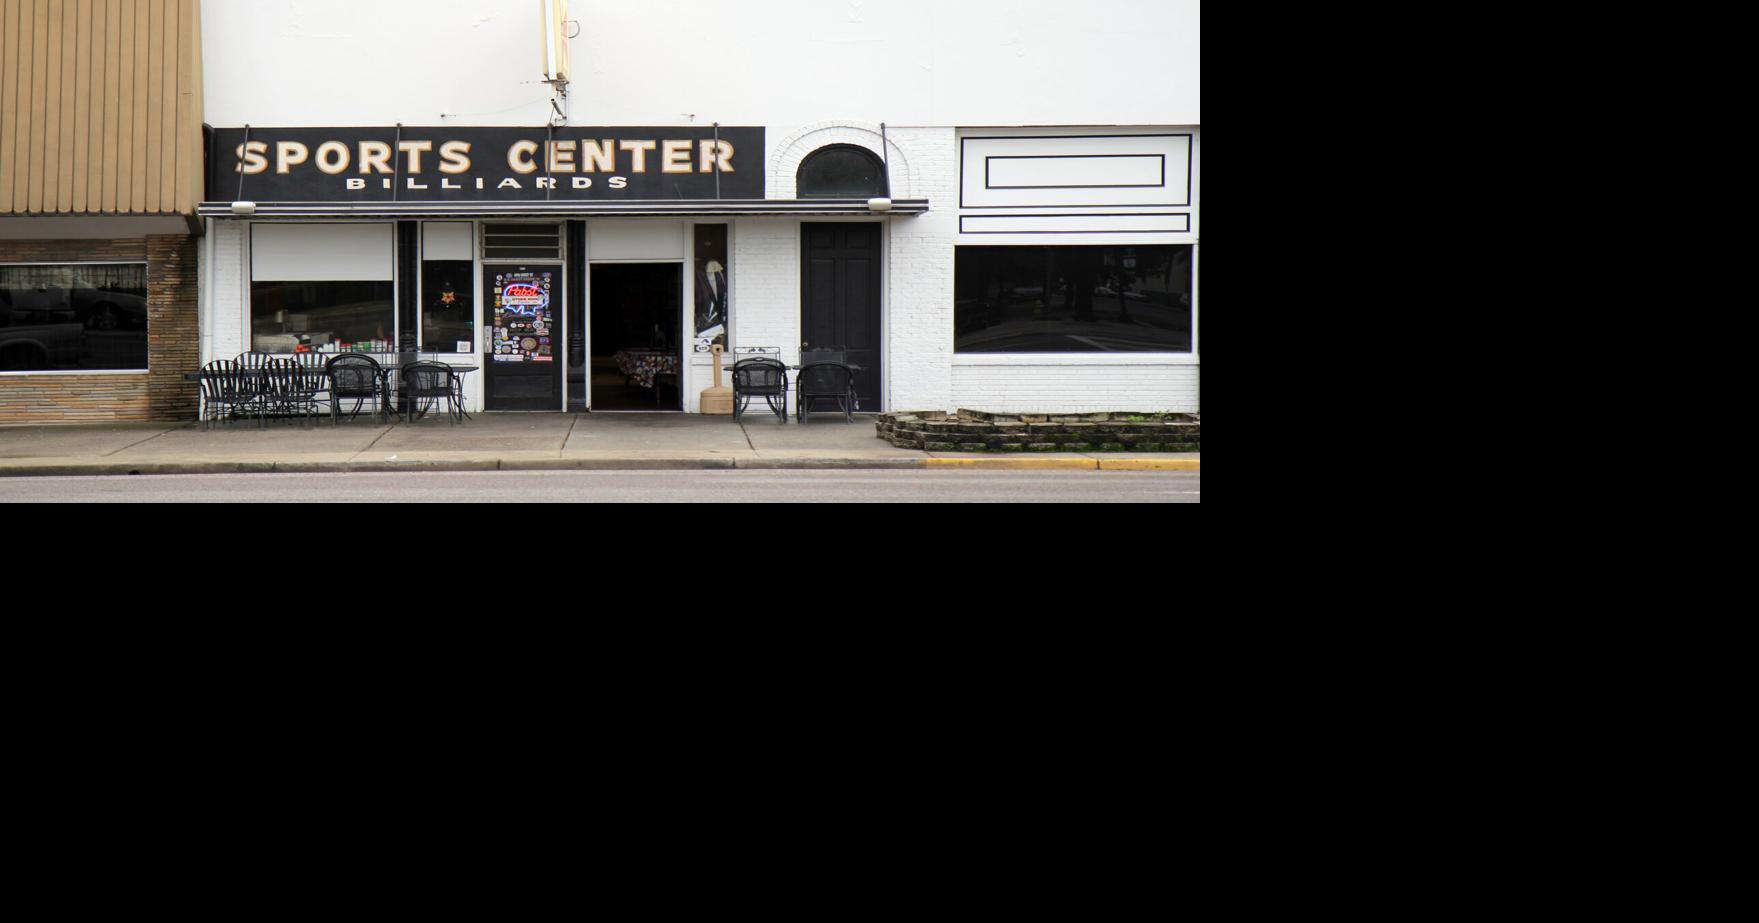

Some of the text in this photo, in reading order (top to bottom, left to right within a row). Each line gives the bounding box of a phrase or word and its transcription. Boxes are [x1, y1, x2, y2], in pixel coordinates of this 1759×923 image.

[235, 139, 736, 174] SPORTS CENTER
[346, 176, 628, 190] BILLIARDS
[508, 286, 539, 296] Pabst
